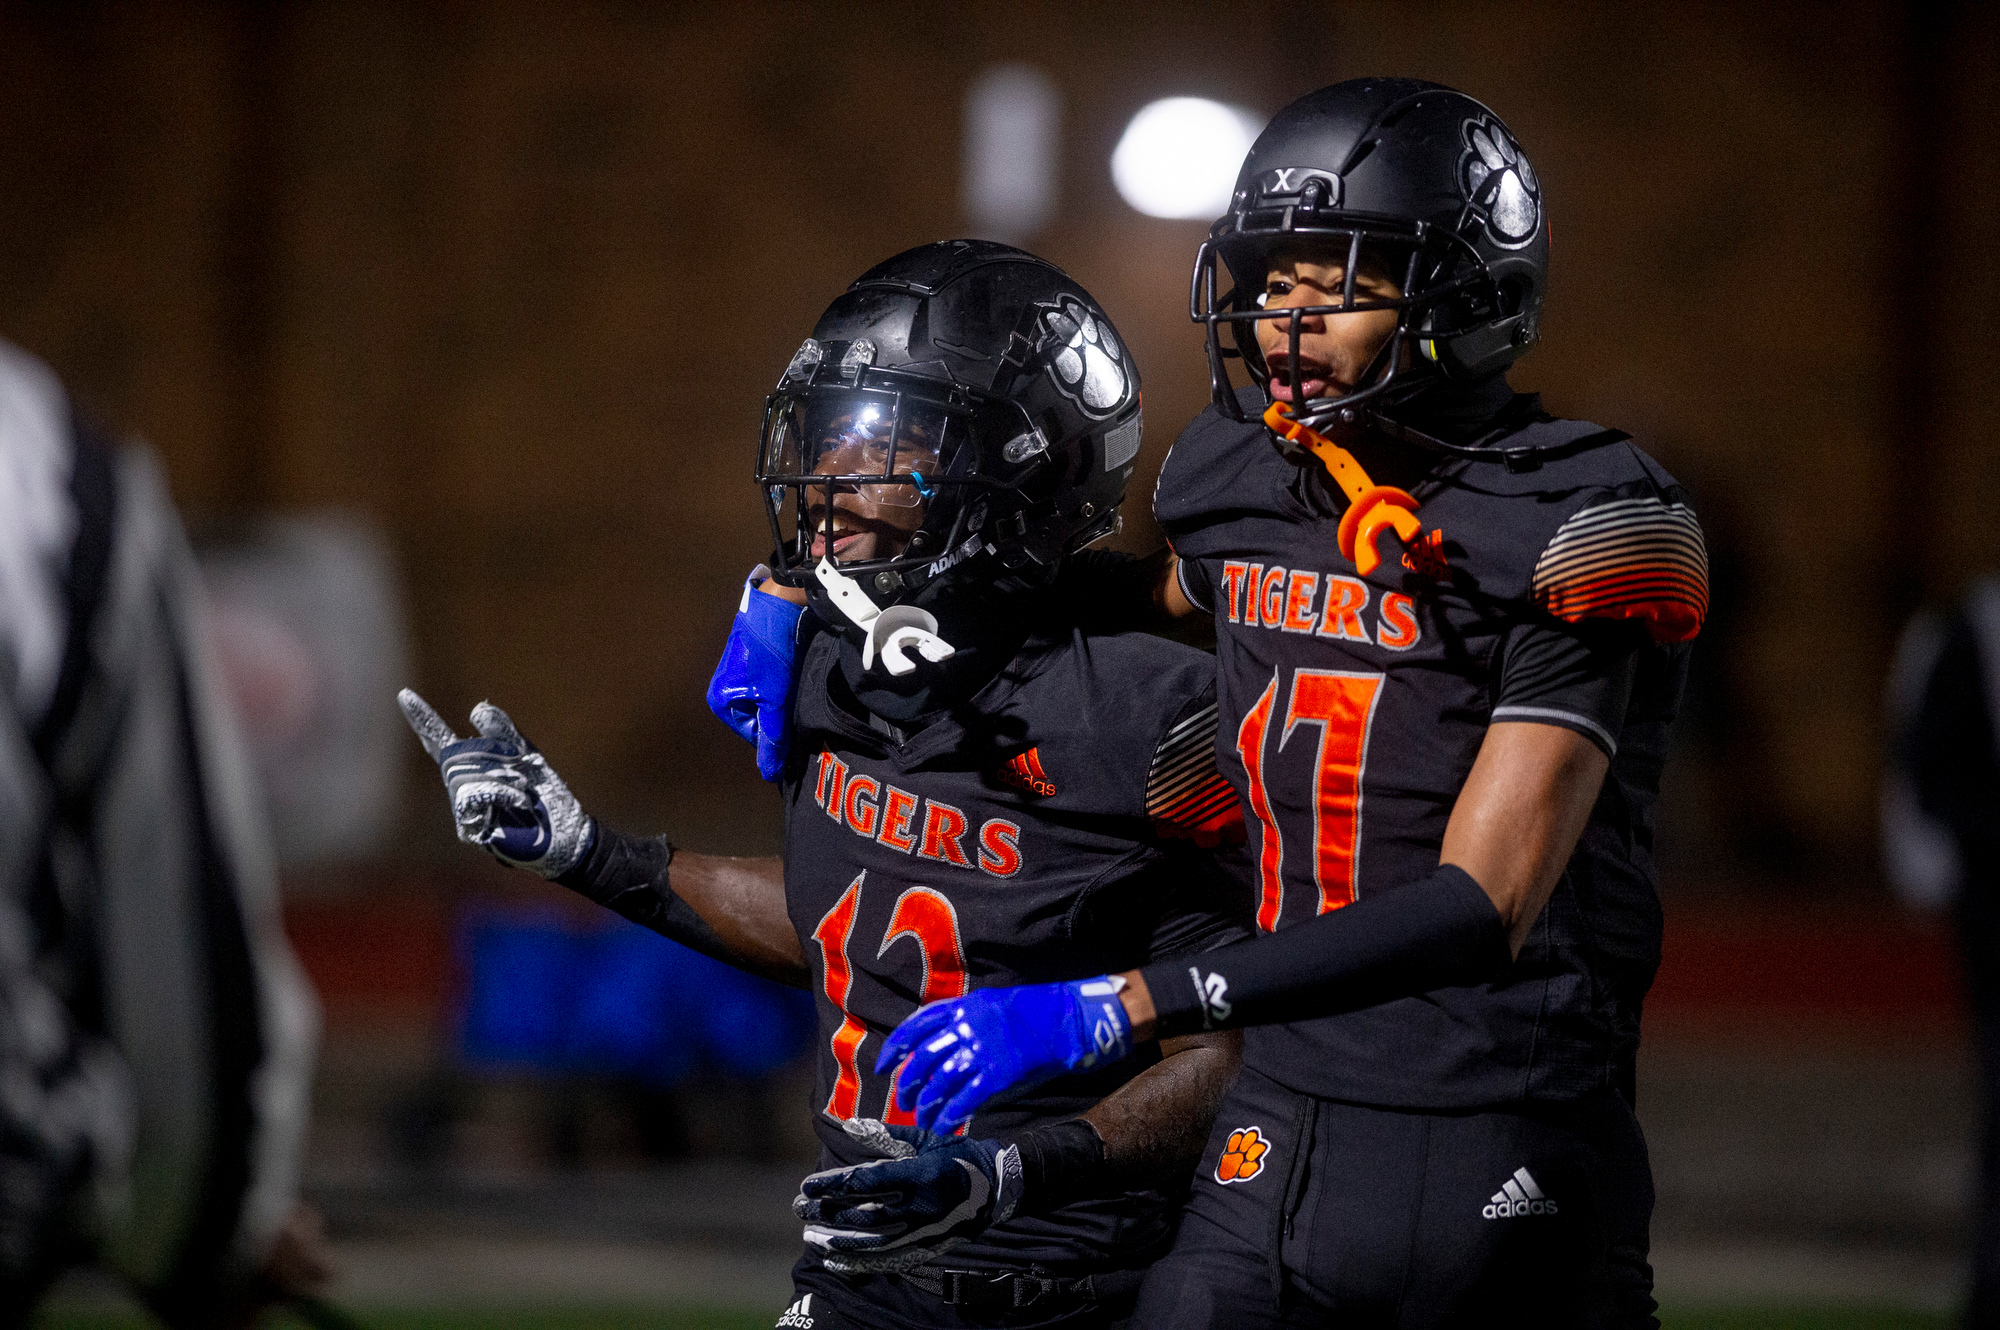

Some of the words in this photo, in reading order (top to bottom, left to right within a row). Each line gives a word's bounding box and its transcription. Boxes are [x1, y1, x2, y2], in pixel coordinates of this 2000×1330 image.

[1221, 560, 1421, 651] TIGERS
[815, 750, 1023, 879] TIGERS
[1236, 664, 1386, 933] 17
[1482, 1198, 1558, 1219] adidas
